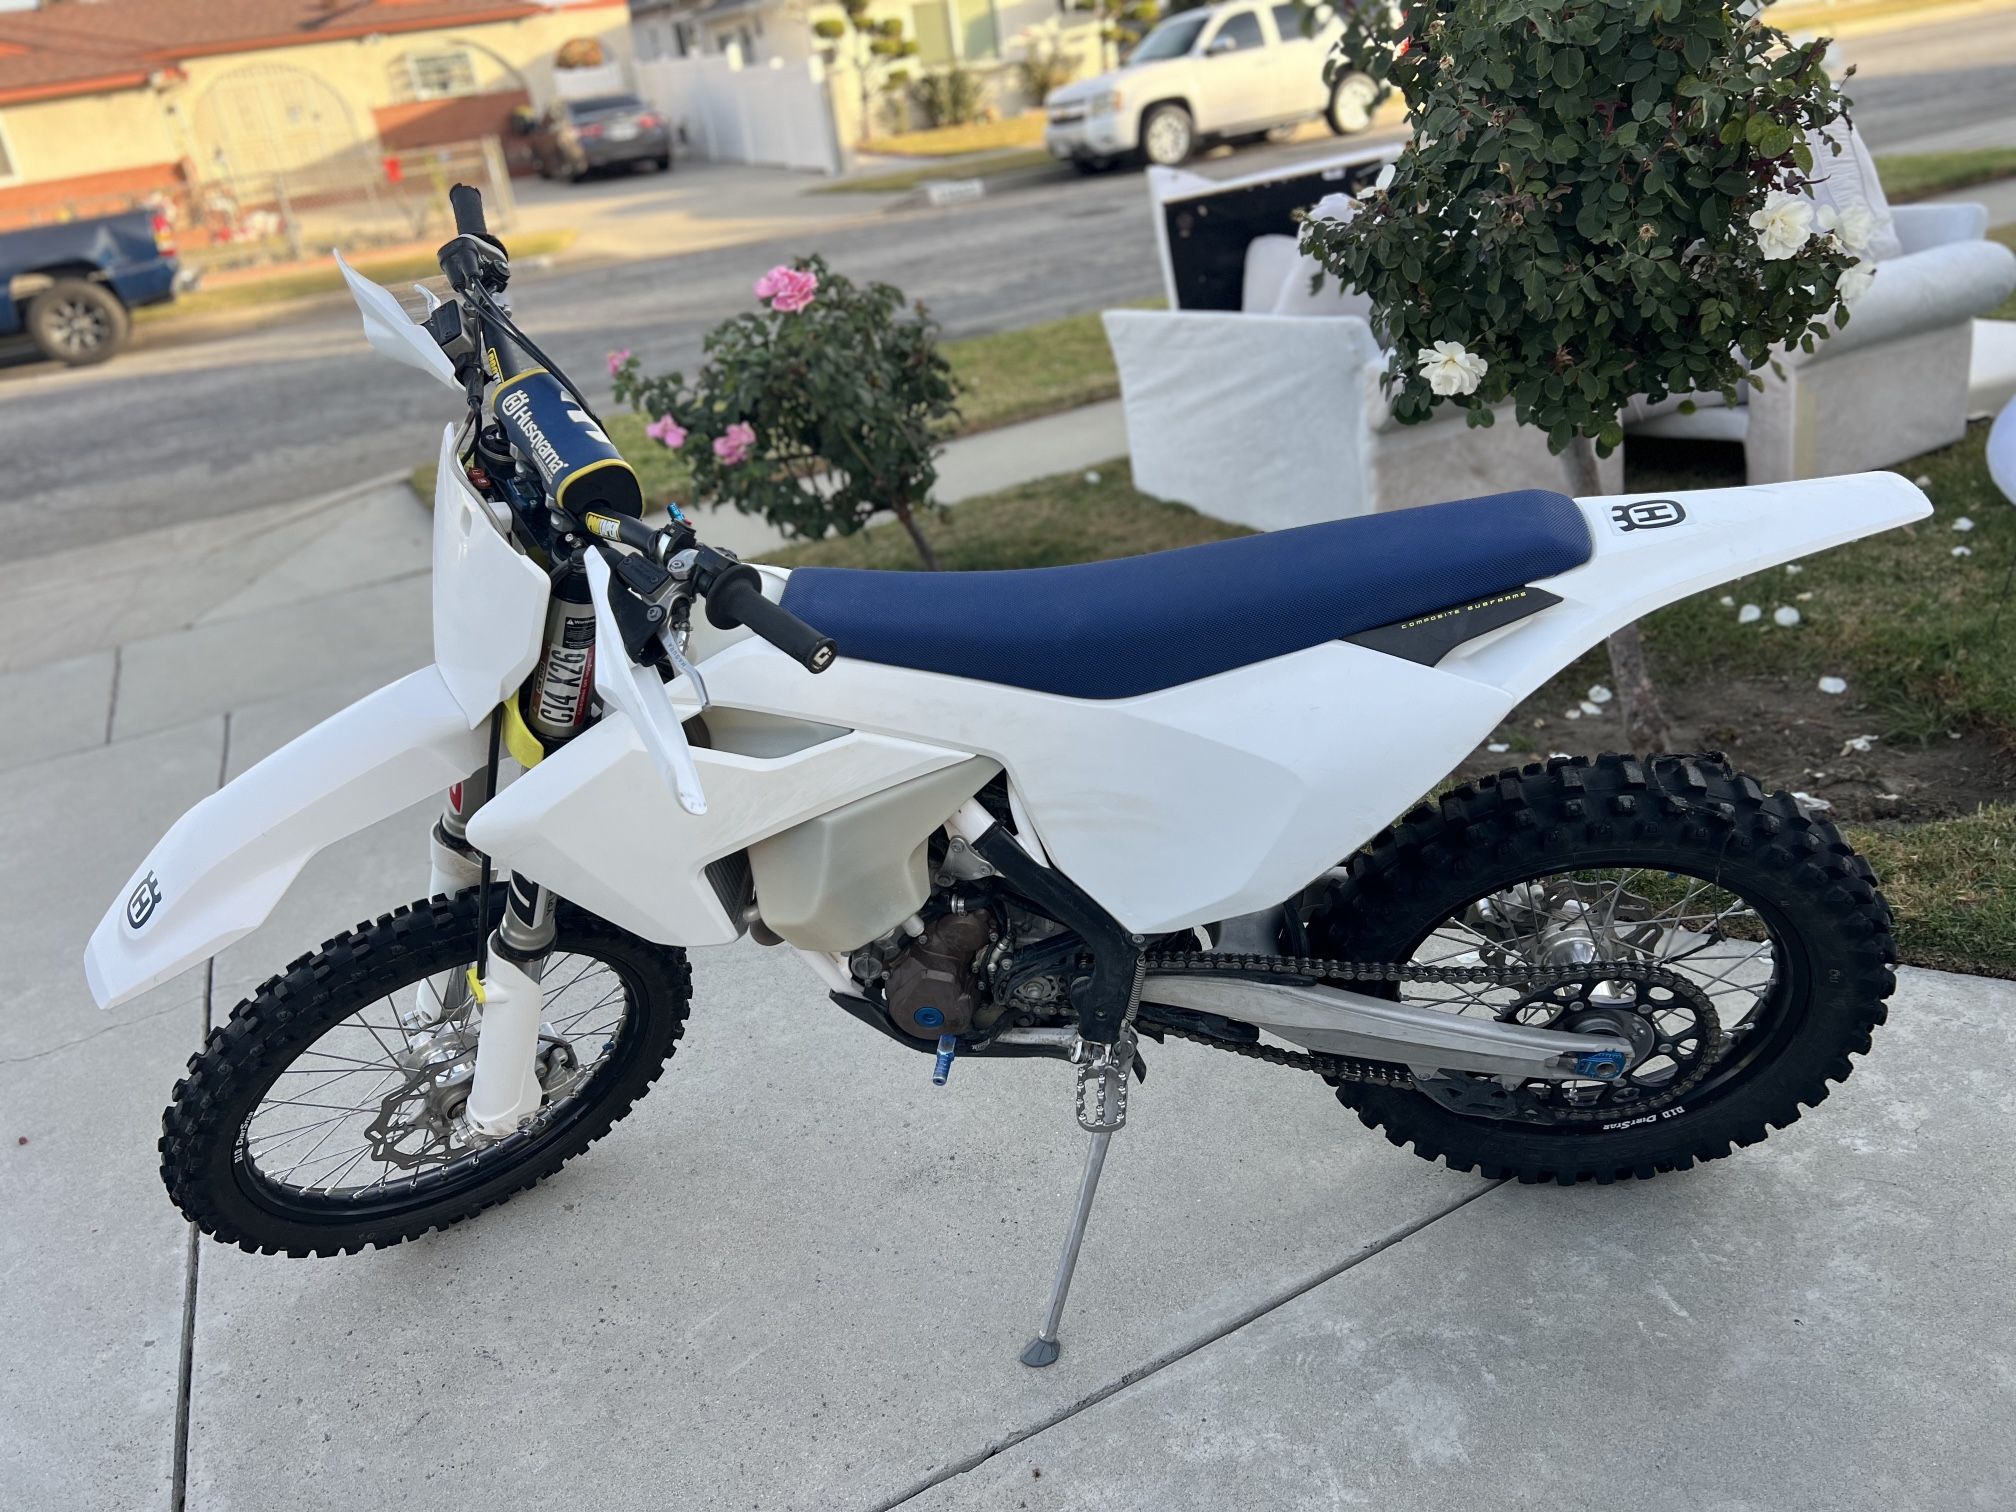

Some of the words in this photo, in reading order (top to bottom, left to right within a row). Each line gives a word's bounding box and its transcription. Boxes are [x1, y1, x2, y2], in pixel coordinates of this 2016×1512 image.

[513, 406, 566, 474] Husqvarna
[1401, 609, 1460, 629] COMPOSITE
[1467, 591, 1527, 611] SUBFRAME
[1662, 1106, 1685, 1119] DID
